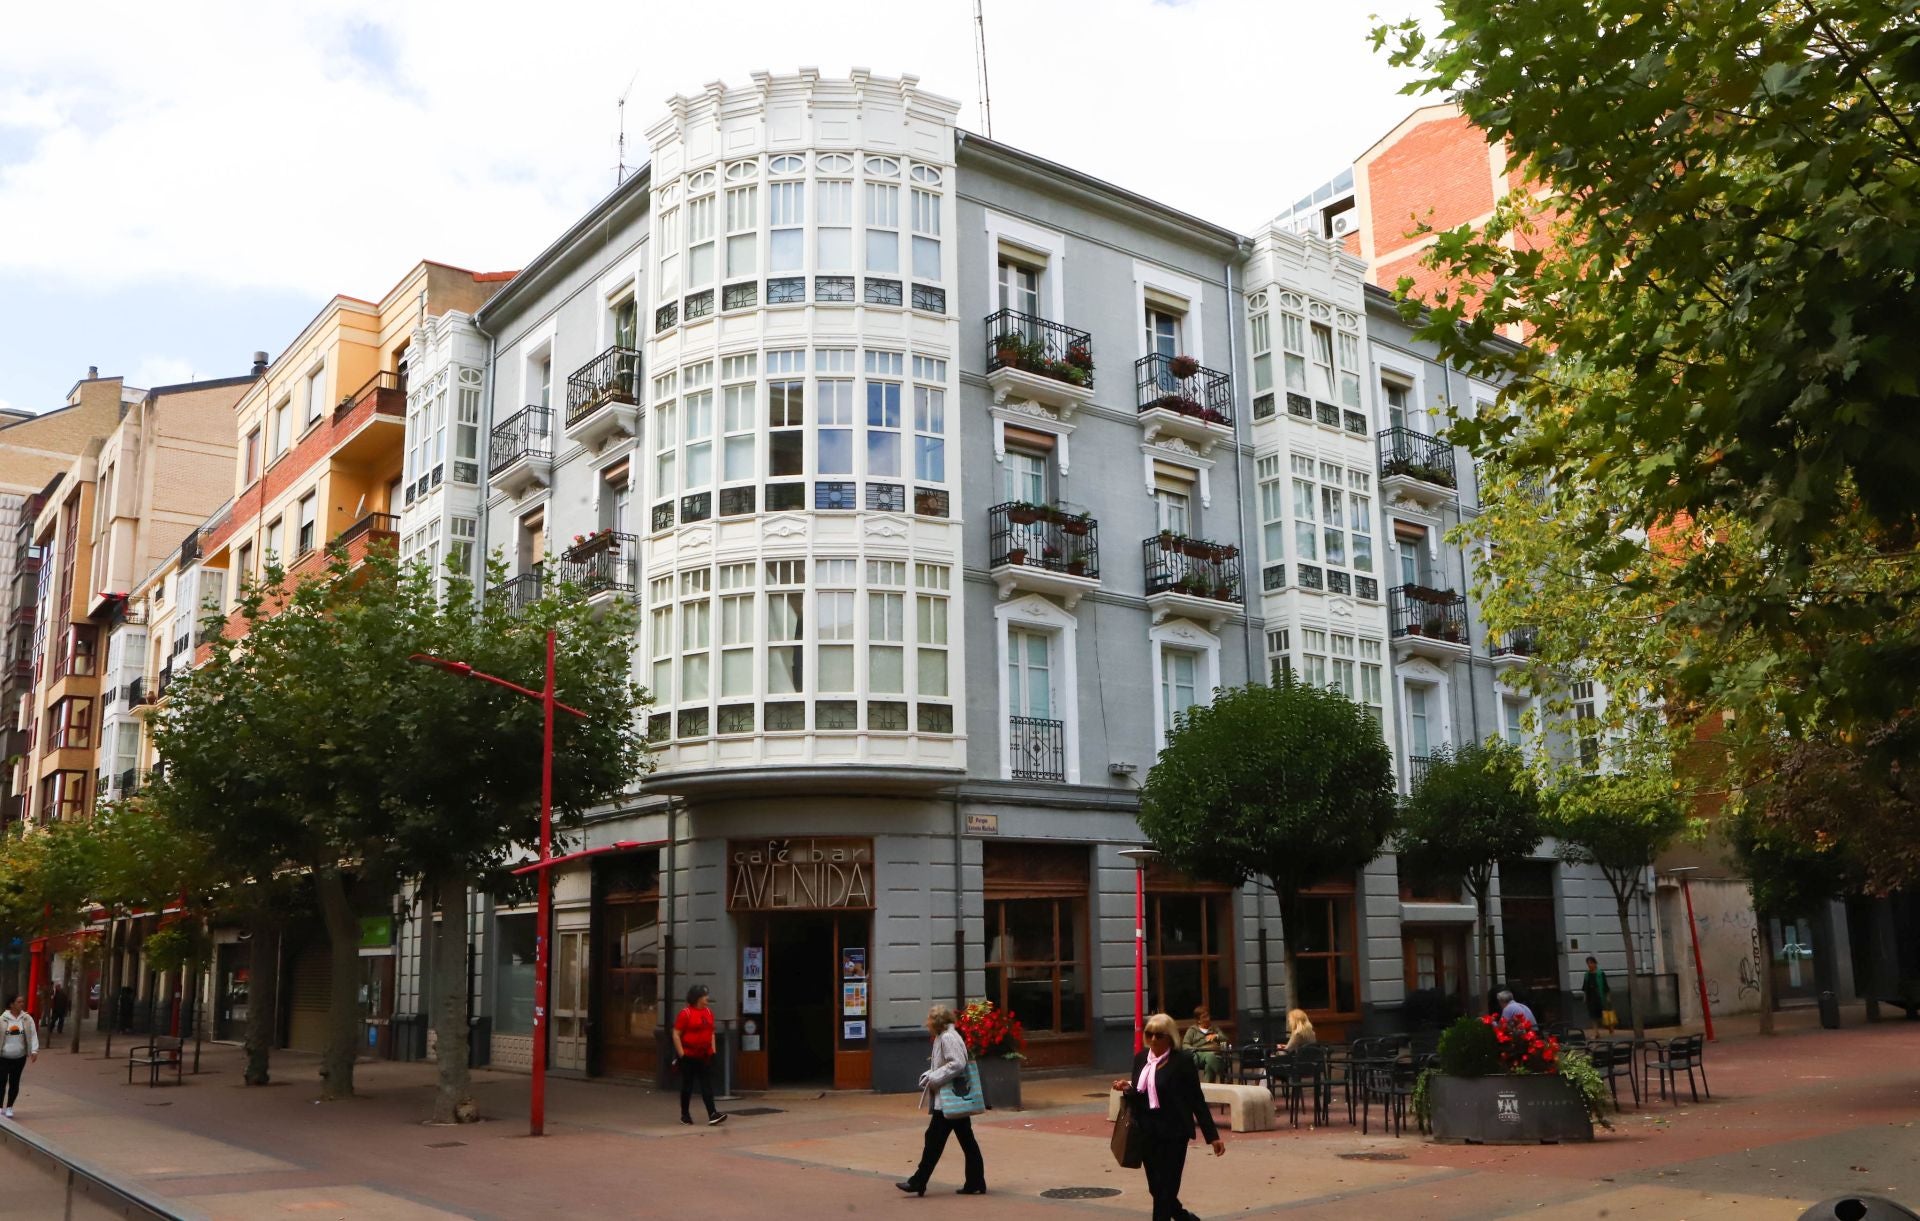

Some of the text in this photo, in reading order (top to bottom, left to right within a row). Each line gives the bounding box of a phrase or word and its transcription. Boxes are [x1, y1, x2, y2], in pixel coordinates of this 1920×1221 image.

[734, 840, 865, 864] café bar
[730, 862, 870, 908] AVENIDA
